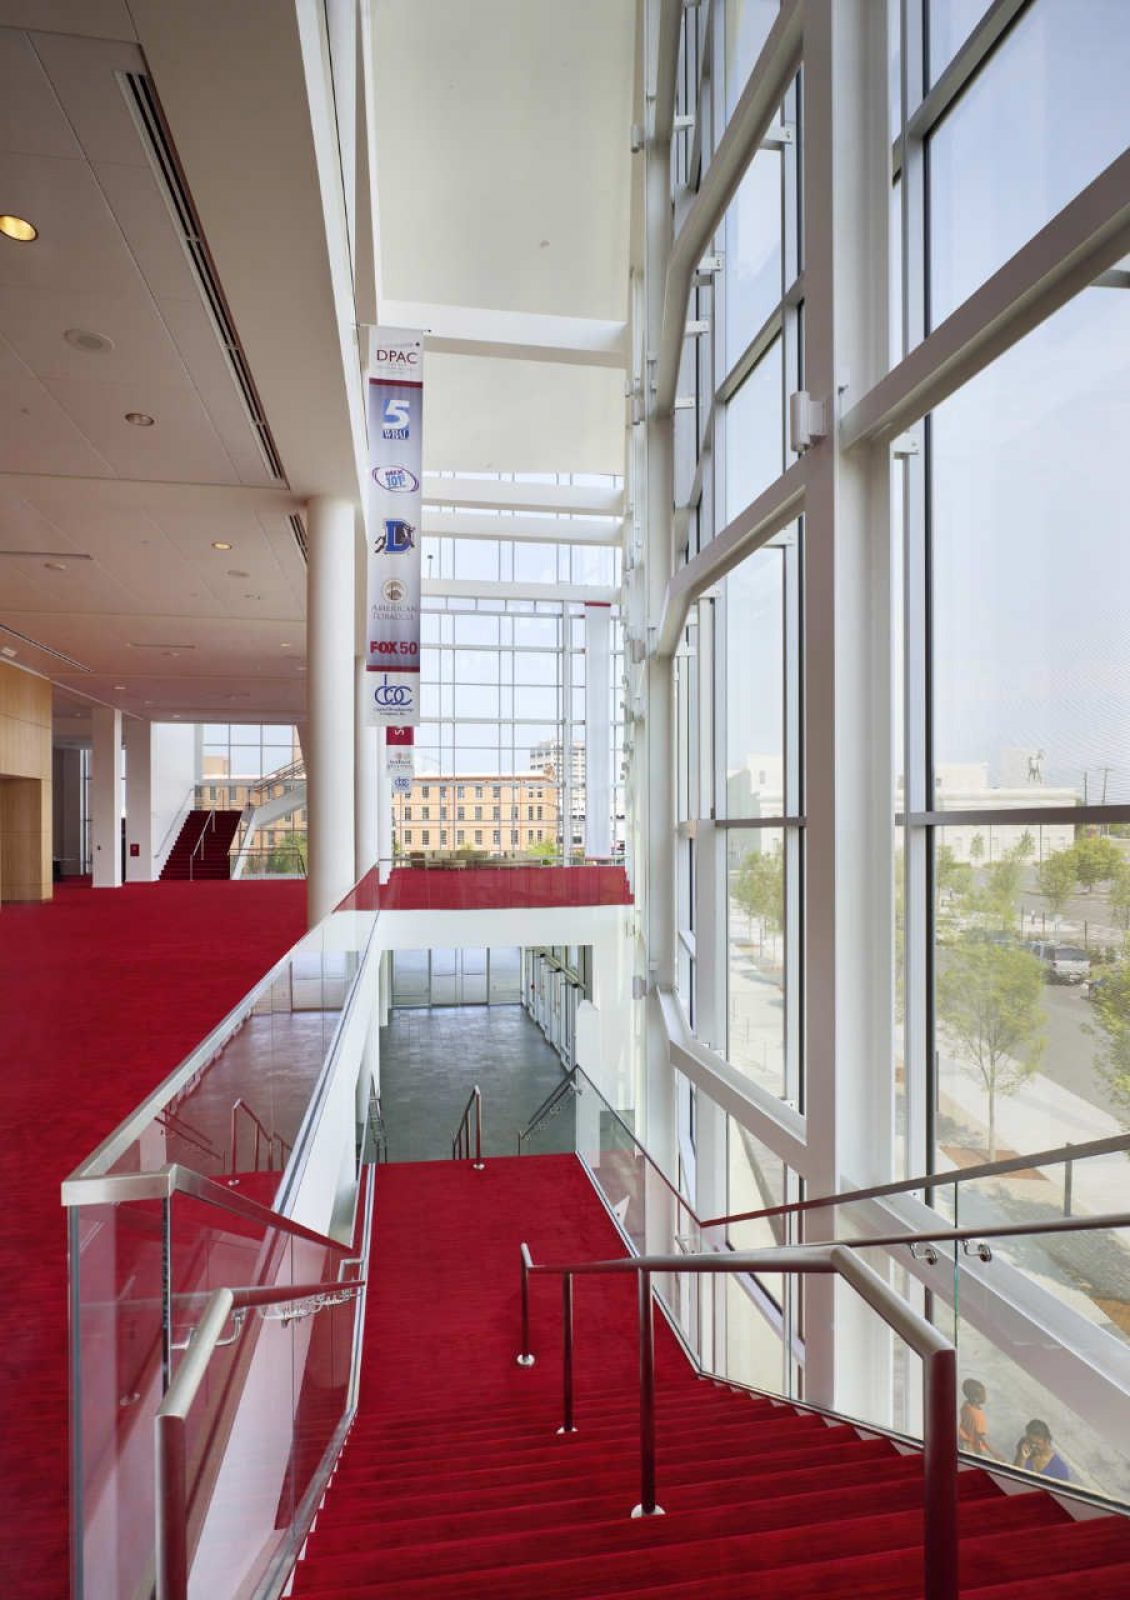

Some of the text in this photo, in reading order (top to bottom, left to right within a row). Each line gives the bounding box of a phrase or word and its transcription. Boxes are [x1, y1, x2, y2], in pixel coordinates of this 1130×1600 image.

[376, 349, 418, 365] DPAC
[381, 399, 410, 430] 5
[369, 640, 417, 655] FOX 50
